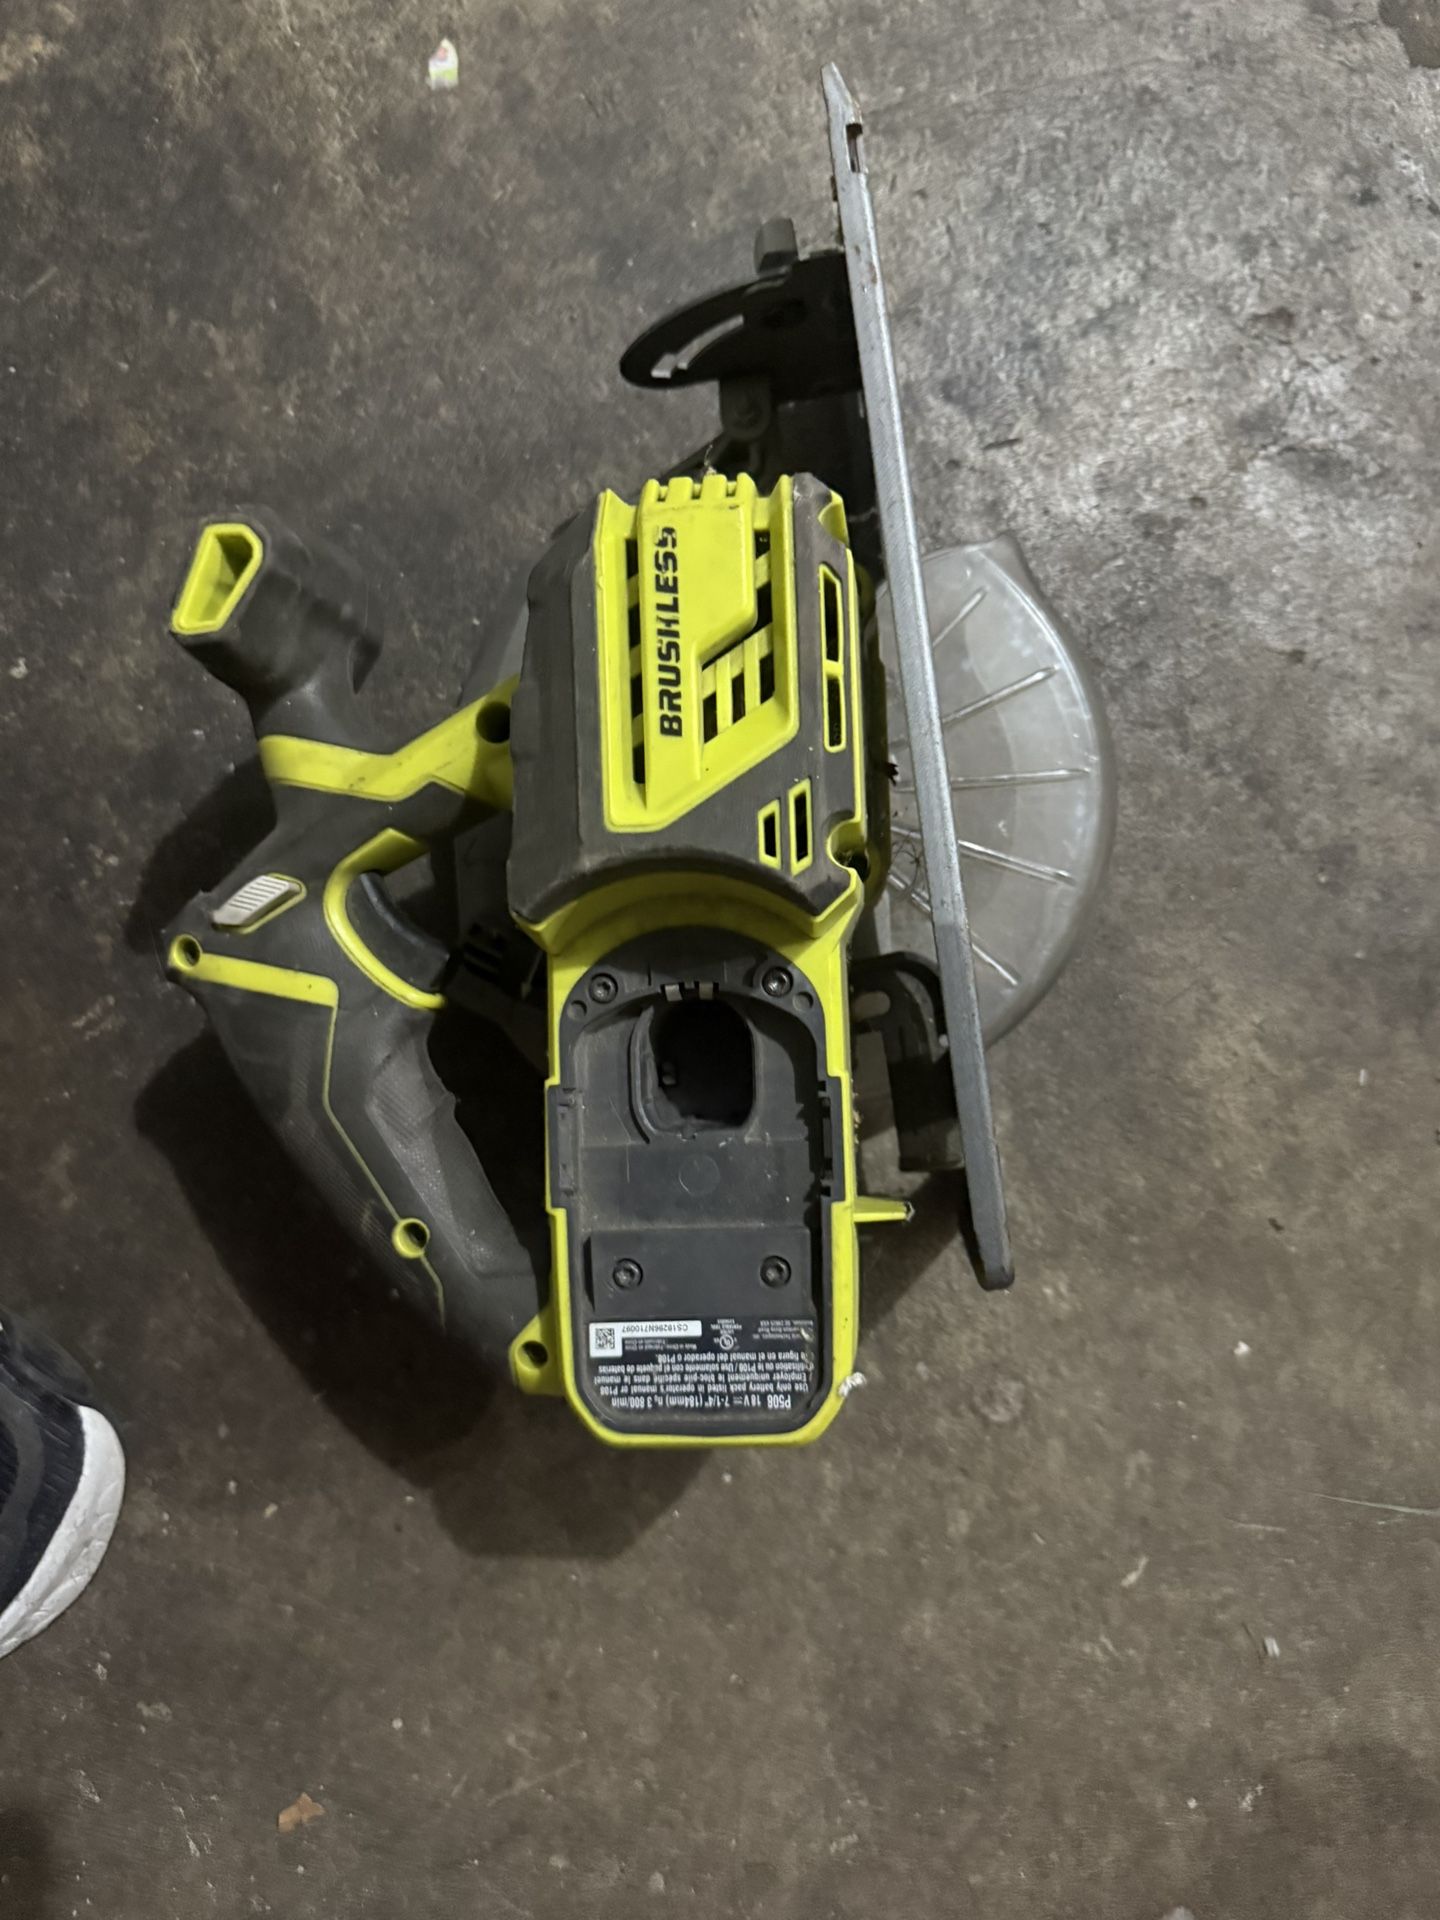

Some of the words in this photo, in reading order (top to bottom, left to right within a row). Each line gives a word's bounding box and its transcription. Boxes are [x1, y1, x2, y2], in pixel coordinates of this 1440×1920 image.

[654, 527, 683, 737] BRUSHLESS
[684, 1351, 715, 1362] operador
[716, 1352, 728, 1362] del
[730, 1352, 756, 1362] manual
[758, 1352, 766, 1362] el
[766, 1352, 776, 1360] en
[778, 1350, 799, 1361] figura
[626, 1364, 635, 1374] de
[664, 1364, 670, 1373] el
[671, 1364, 684, 1372] con
[685, 1363, 720, 1373] solamente
[720, 1363, 734, 1372] Use
[757, 1363, 764, 1372] le
[594, 1375, 621, 1384] manuel
[623, 1374, 630, 1384] le
[633, 1374, 650, 1384] dans
[684, 1372, 715, 1383] bloc-pile
[718, 1373, 725, 1383] le
[728, 1372, 770, 1383] uniquement
[773, 1371, 806, 1382] Employer
[600, 1386, 618, 1396] P108
[620, 1385, 628, 1393] or
[630, 1385, 657, 1394] manual
[660, 1382, 695, 1394] operator's
[698, 1384, 704, 1393] in
[707, 1384, 727, 1393] listed
[730, 1382, 746, 1393] pack
[749, 1382, 774, 1393] battery
[777, 1382, 792, 1392] only
[794, 1383, 808, 1392] Use
[666, 1393, 702, 1408] (184mm)
[767, 1394, 792, 1408] P508
